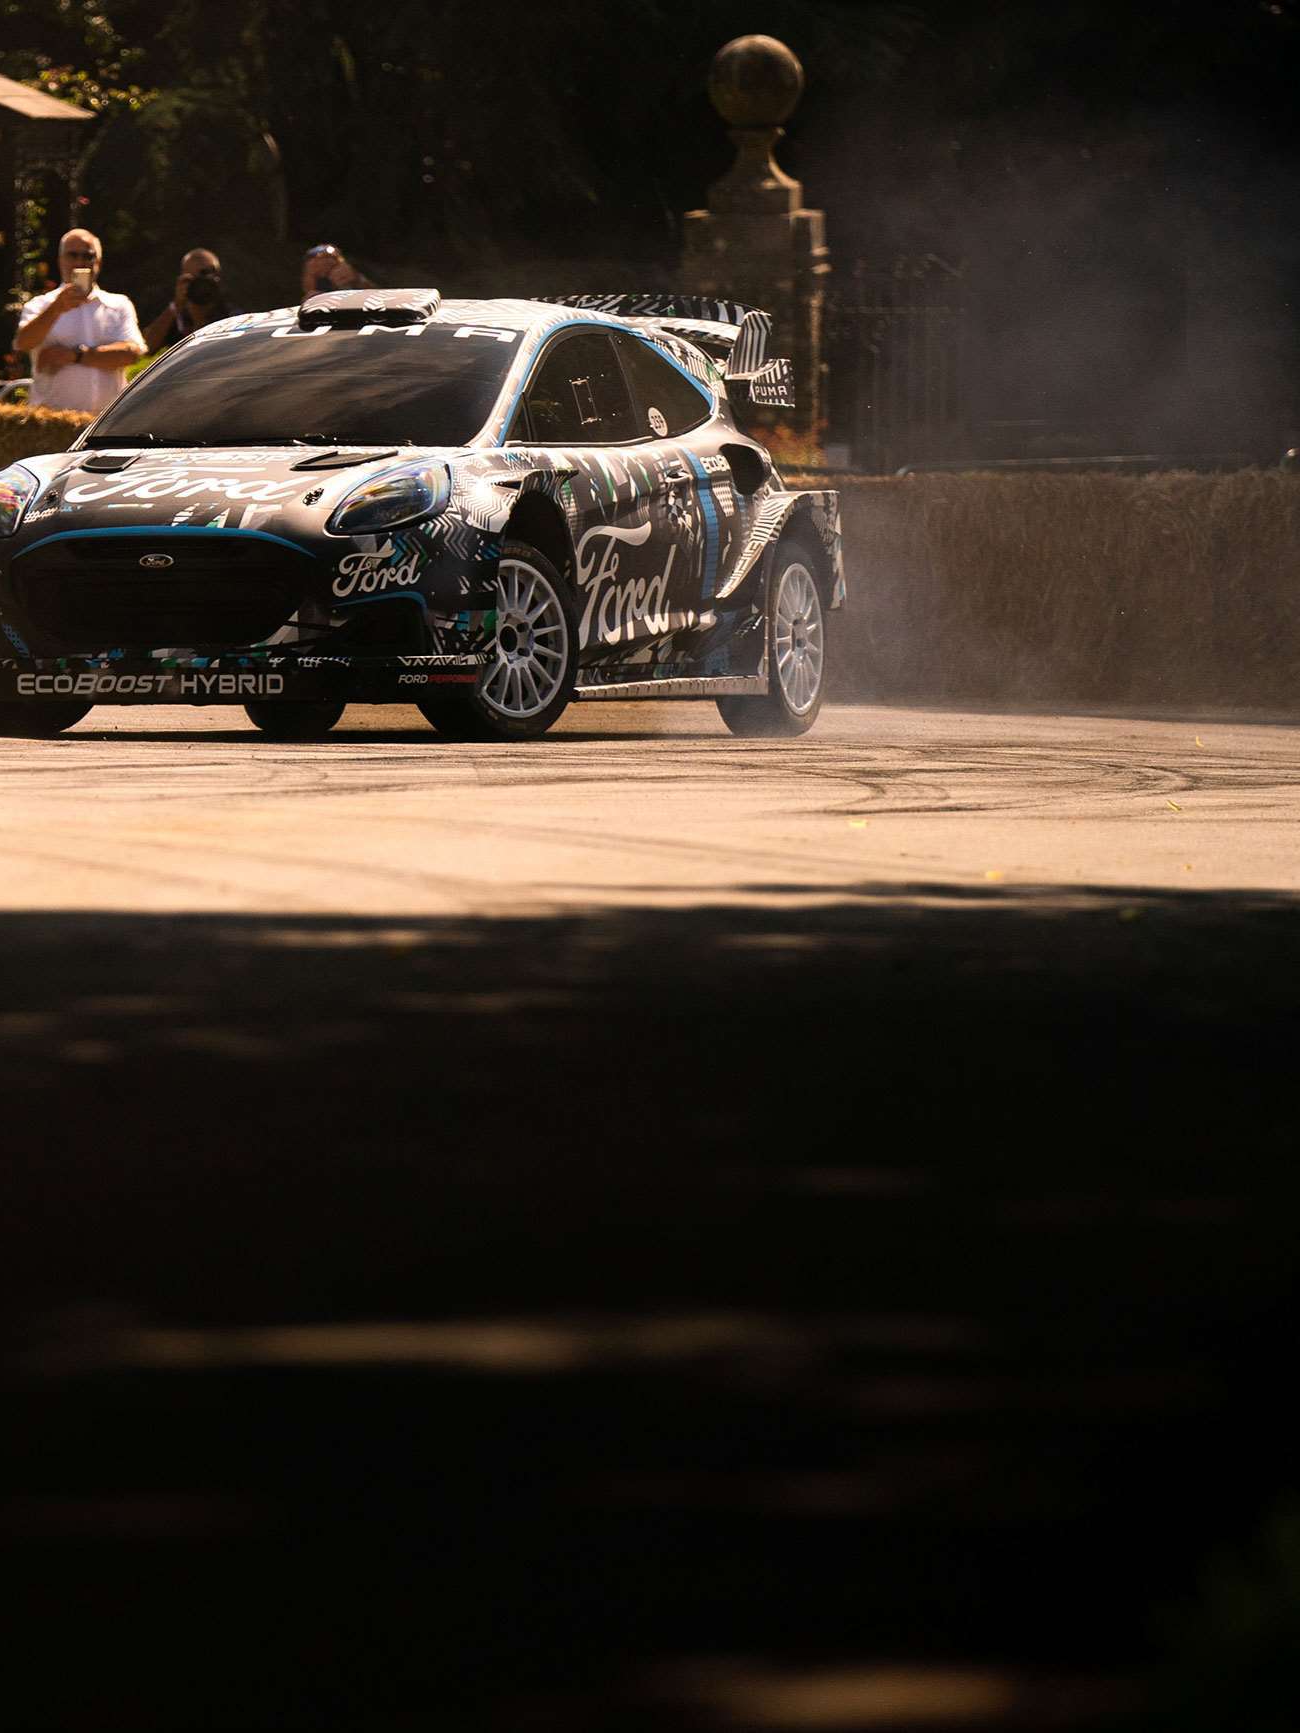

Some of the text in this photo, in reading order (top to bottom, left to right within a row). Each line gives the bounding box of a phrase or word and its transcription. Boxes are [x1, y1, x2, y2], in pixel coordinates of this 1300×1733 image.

[186, 319, 518, 347] PUMA
[754, 385, 788, 397] PUMA
[64, 467, 319, 503] Ford
[332, 548, 421, 597] Ford
[577, 521, 677, 650] Ford
[180, 673, 284, 695] HYBRID
[398, 674, 428, 684] FORD
